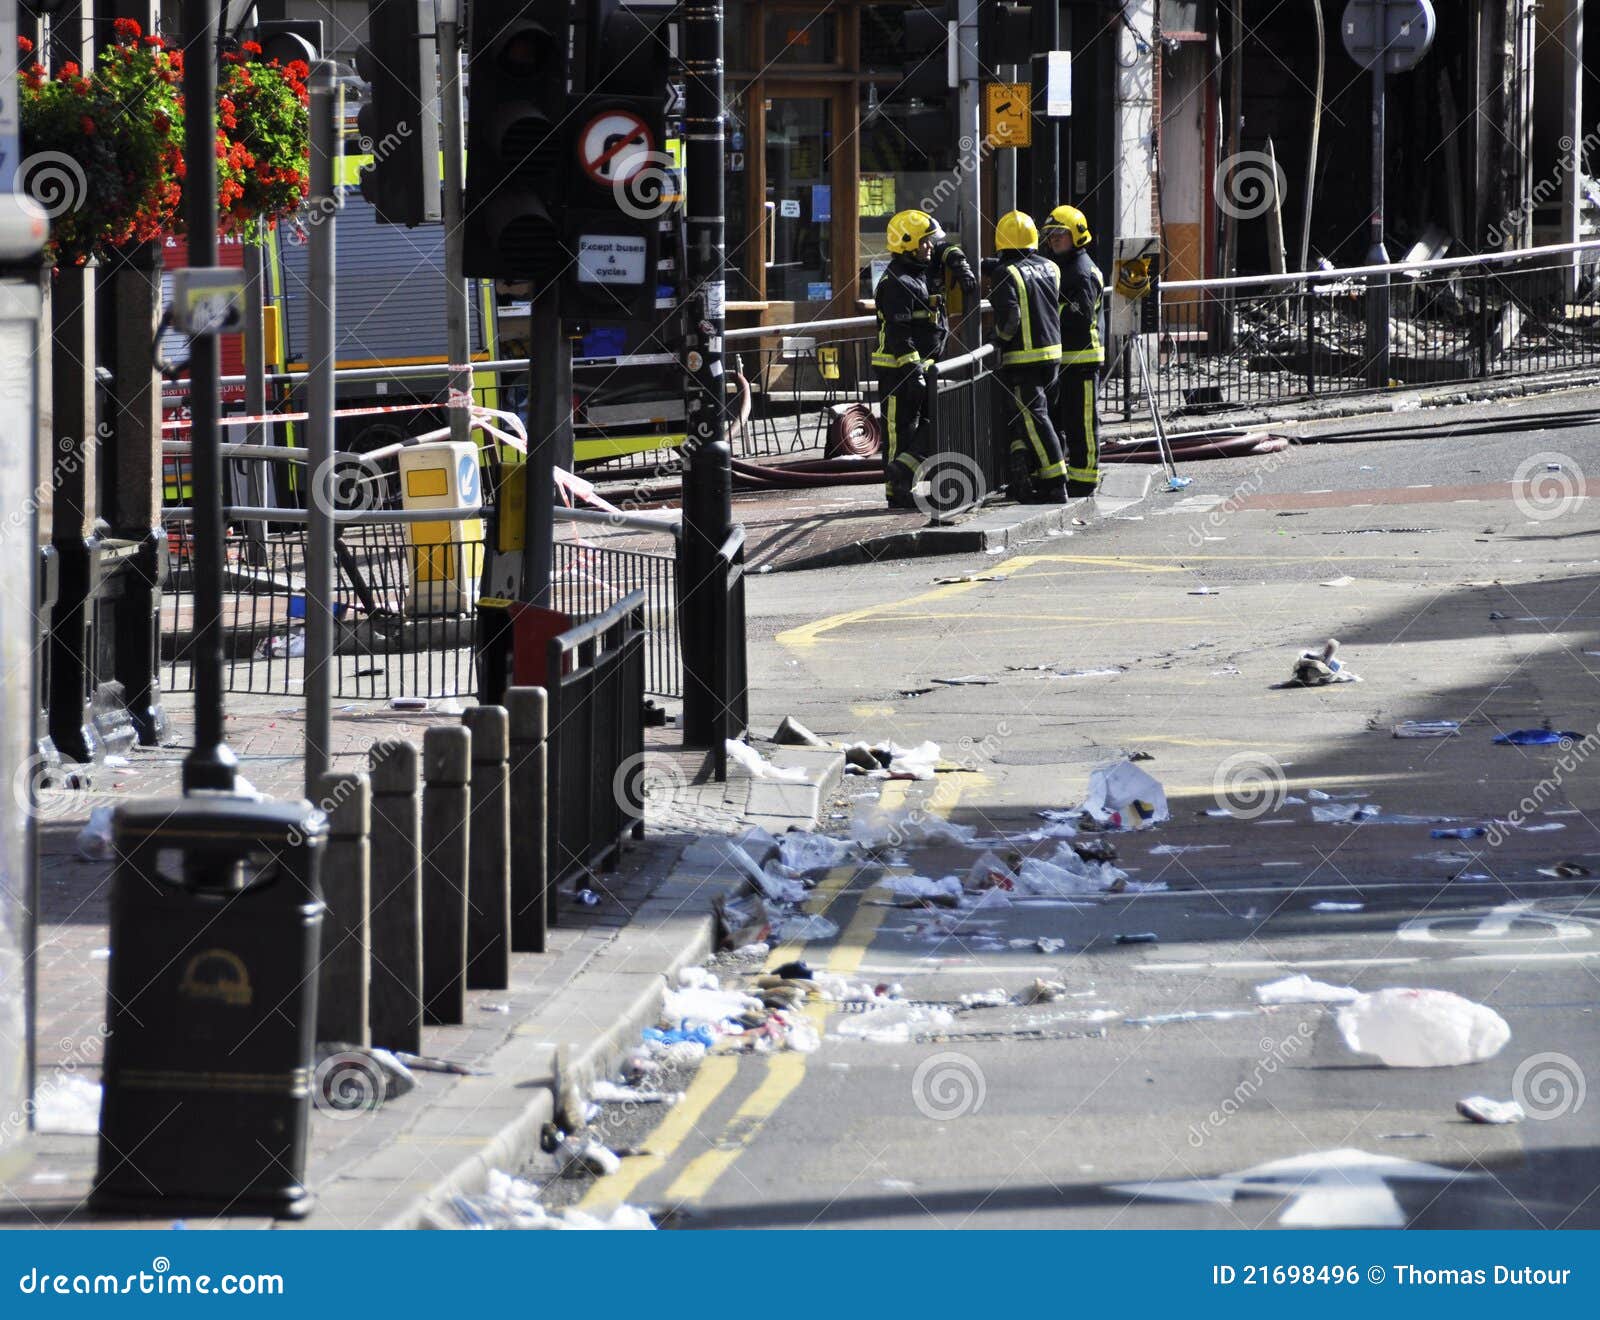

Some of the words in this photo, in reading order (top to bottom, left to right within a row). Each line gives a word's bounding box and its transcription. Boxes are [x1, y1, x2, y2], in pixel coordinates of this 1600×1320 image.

[994, 90, 1022, 99] CCTV
[581, 242, 613, 252] Except
[616, 243, 645, 253] buses
[608, 255, 616, 263] &
[596, 268, 627, 276] cycles
